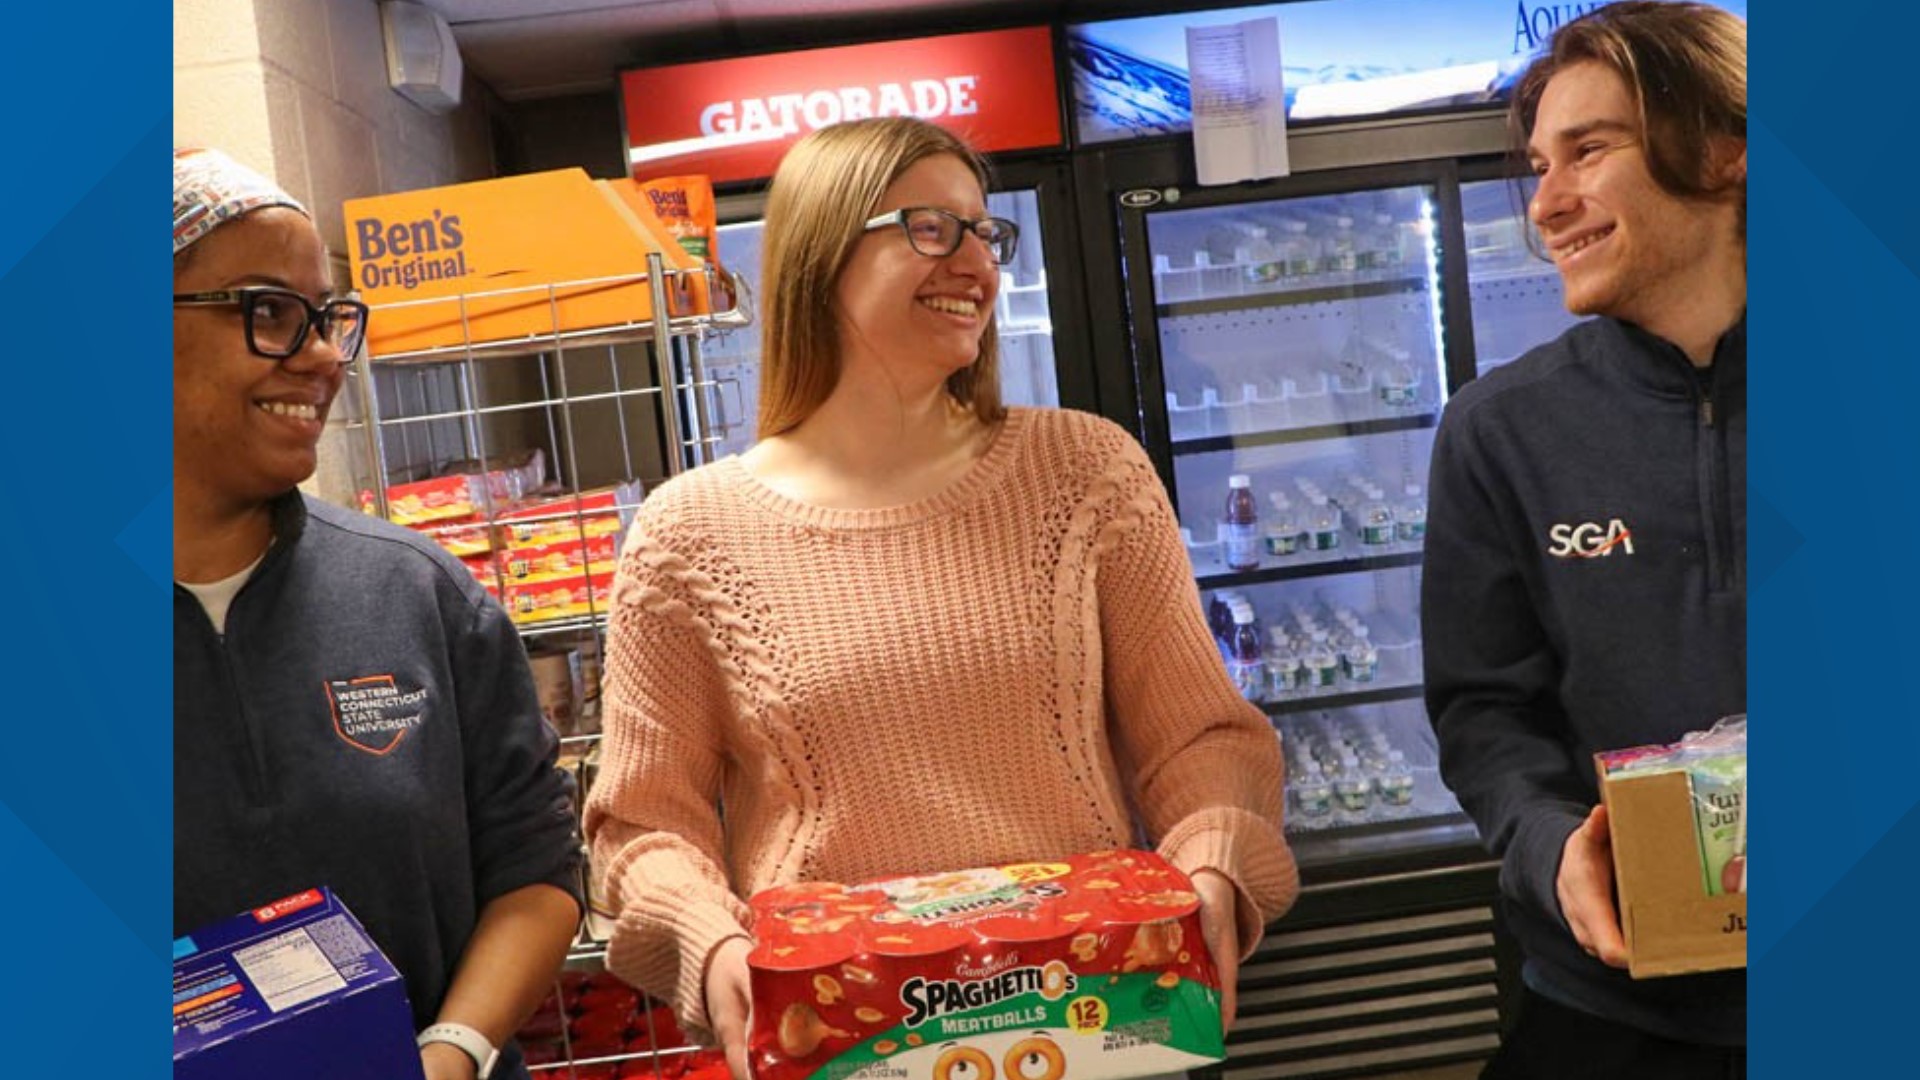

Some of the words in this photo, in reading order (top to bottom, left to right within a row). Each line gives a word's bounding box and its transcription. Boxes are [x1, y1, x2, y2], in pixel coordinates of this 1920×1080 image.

[700, 75, 978, 137] GATORADE
[356, 208, 464, 261] Ben's
[361, 250, 467, 290] Original
[1548, 518, 1635, 558] SGA
[336, 686, 399, 702] WESTERN
[340, 689, 428, 713] CONNECTICUT
[342, 710, 382, 724] STATE
[345, 713, 422, 735] UNIVERSITY
[942, 1006, 1047, 1033] MEATBALLS
[1072, 999, 1100, 1021] 12
